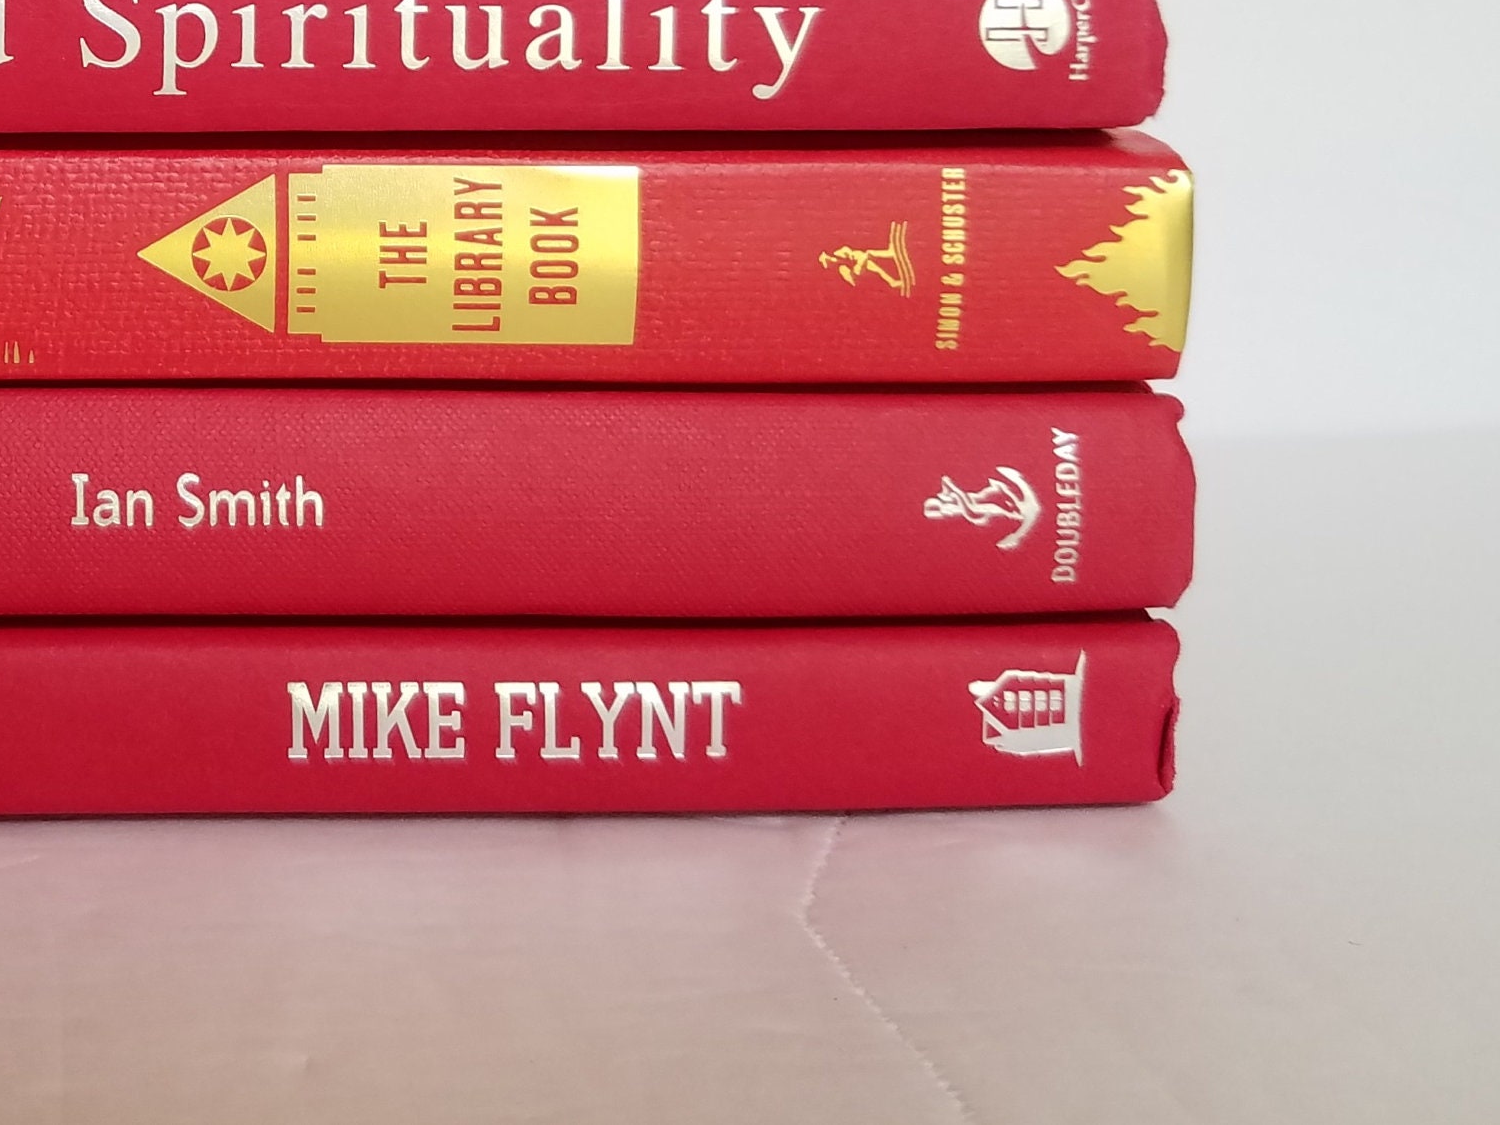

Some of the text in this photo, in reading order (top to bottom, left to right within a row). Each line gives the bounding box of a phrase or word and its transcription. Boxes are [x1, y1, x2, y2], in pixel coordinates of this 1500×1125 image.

[378, 220, 428, 289] THE
[451, 177, 503, 332] LIBRARY
[529, 206, 579, 306] BOOK
[934, 167, 967, 350] SIMON & SCHUSTER
[70, 472, 324, 528] Ian Smith
[1051, 426, 1082, 583] DOUBLEDAY
[286, 681, 741, 761] MIKE FLYNT
